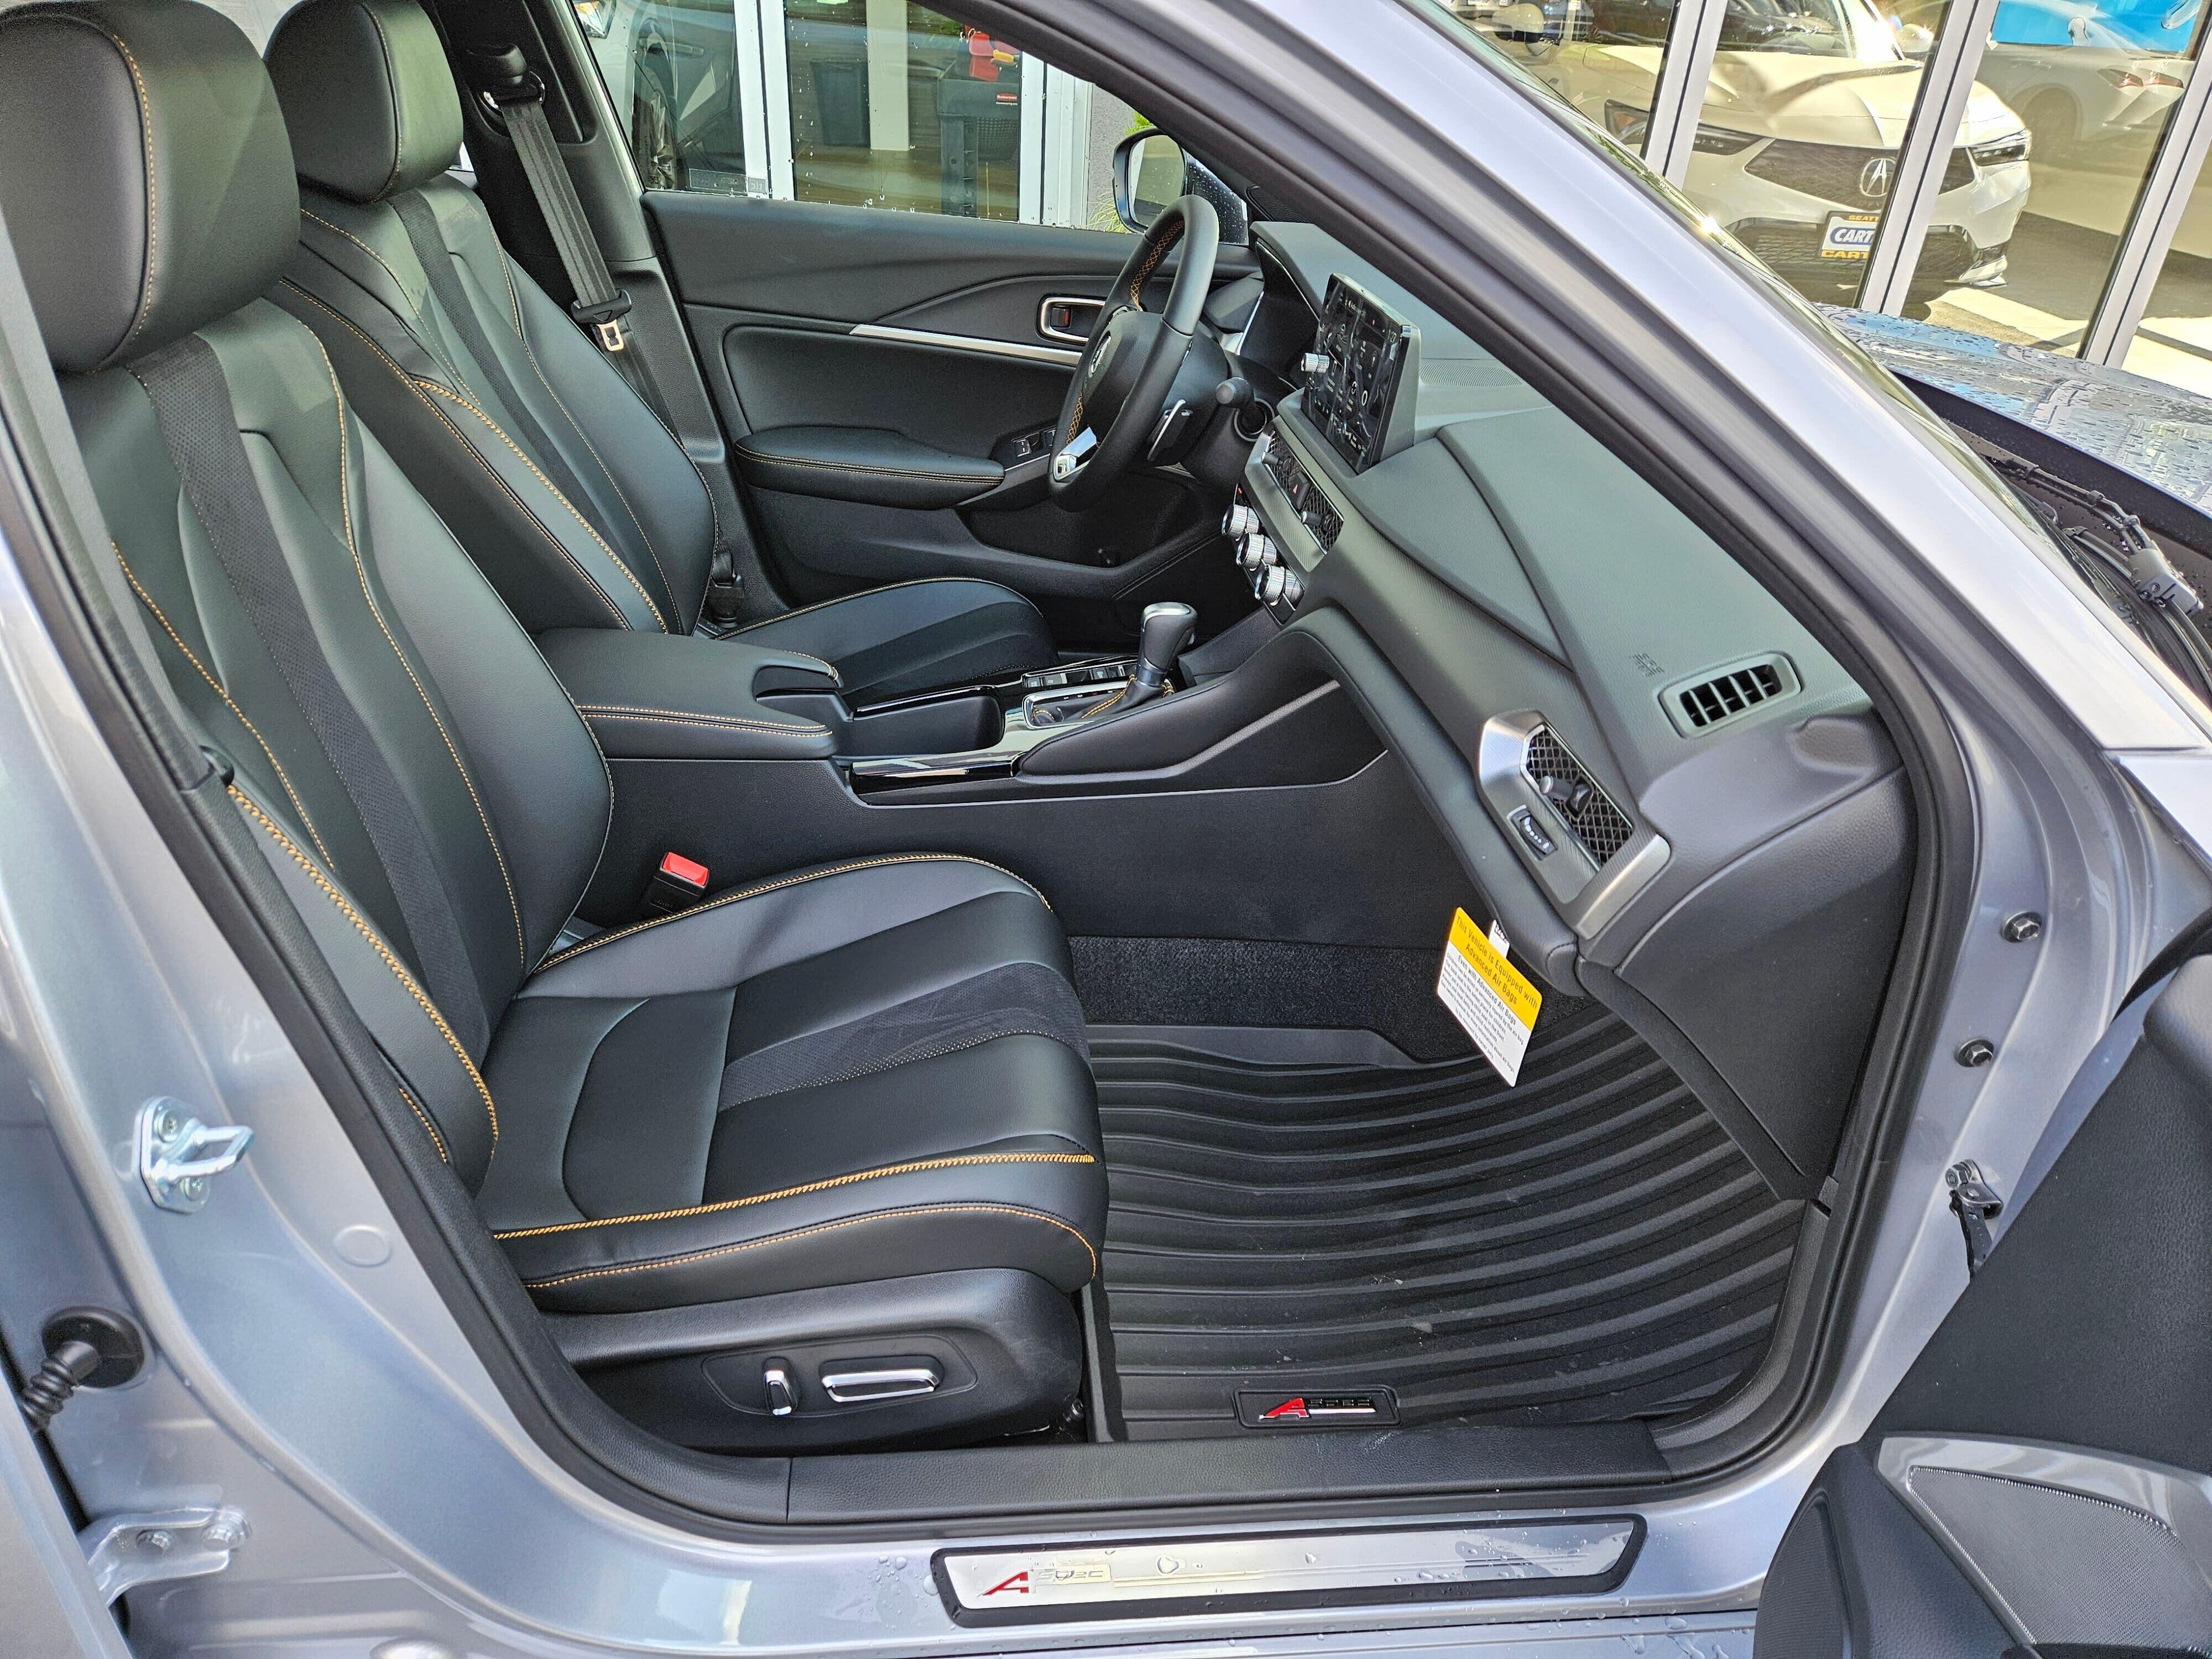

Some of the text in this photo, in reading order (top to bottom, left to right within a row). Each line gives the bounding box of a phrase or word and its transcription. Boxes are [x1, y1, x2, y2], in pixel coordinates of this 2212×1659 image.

[1834, 228, 1875, 243] CART
[1456, 915, 1537, 1009] This Vehicle is Equipped with
[1458, 954, 1468, 970] Even
[1468, 967, 1477, 980] with
[1477, 978, 1497, 1004] Advanced
[1504, 1008, 1516, 1025] Bags
[1465, 943, 1516, 1004] Advanced Air Bags
